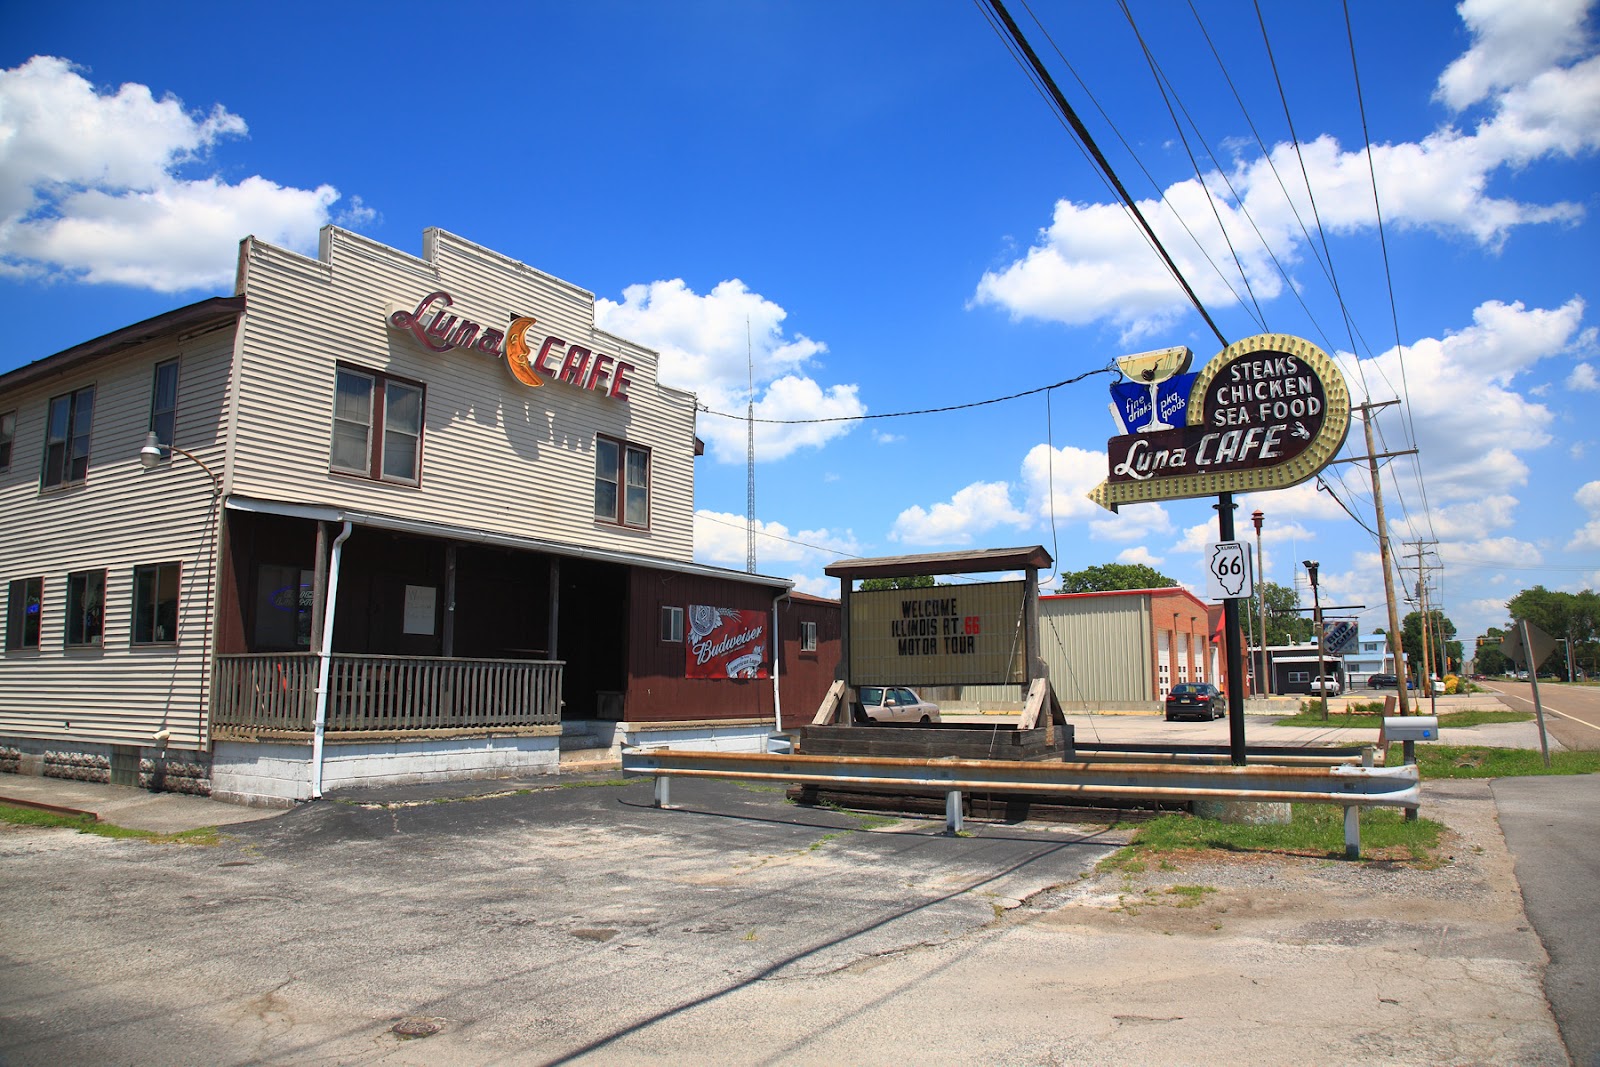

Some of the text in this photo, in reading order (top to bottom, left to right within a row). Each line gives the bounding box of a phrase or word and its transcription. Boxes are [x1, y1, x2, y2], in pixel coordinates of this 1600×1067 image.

[389, 291, 636, 401] Luna CAFE
[1231, 355, 1298, 383] STEAKS
[1216, 375, 1313, 406] CHICKEN
[1126, 396, 1145, 414] fine
[1128, 402, 1152, 423] drinks
[1162, 398, 1186, 422] goods
[1213, 397, 1321, 427] SEA FOOD
[1114, 424, 1287, 480] Luna CAFE
[1218, 555, 1241, 576] 66
[902, 598, 957, 618] WELCOME
[892, 618, 938, 637] ILLINOIS
[1327, 624, 1348, 645] BUD
[1328, 625, 1356, 652] LIGHT
[692, 625, 763, 666] Budweiser
[898, 635, 975, 656] MOTOR TOUR
